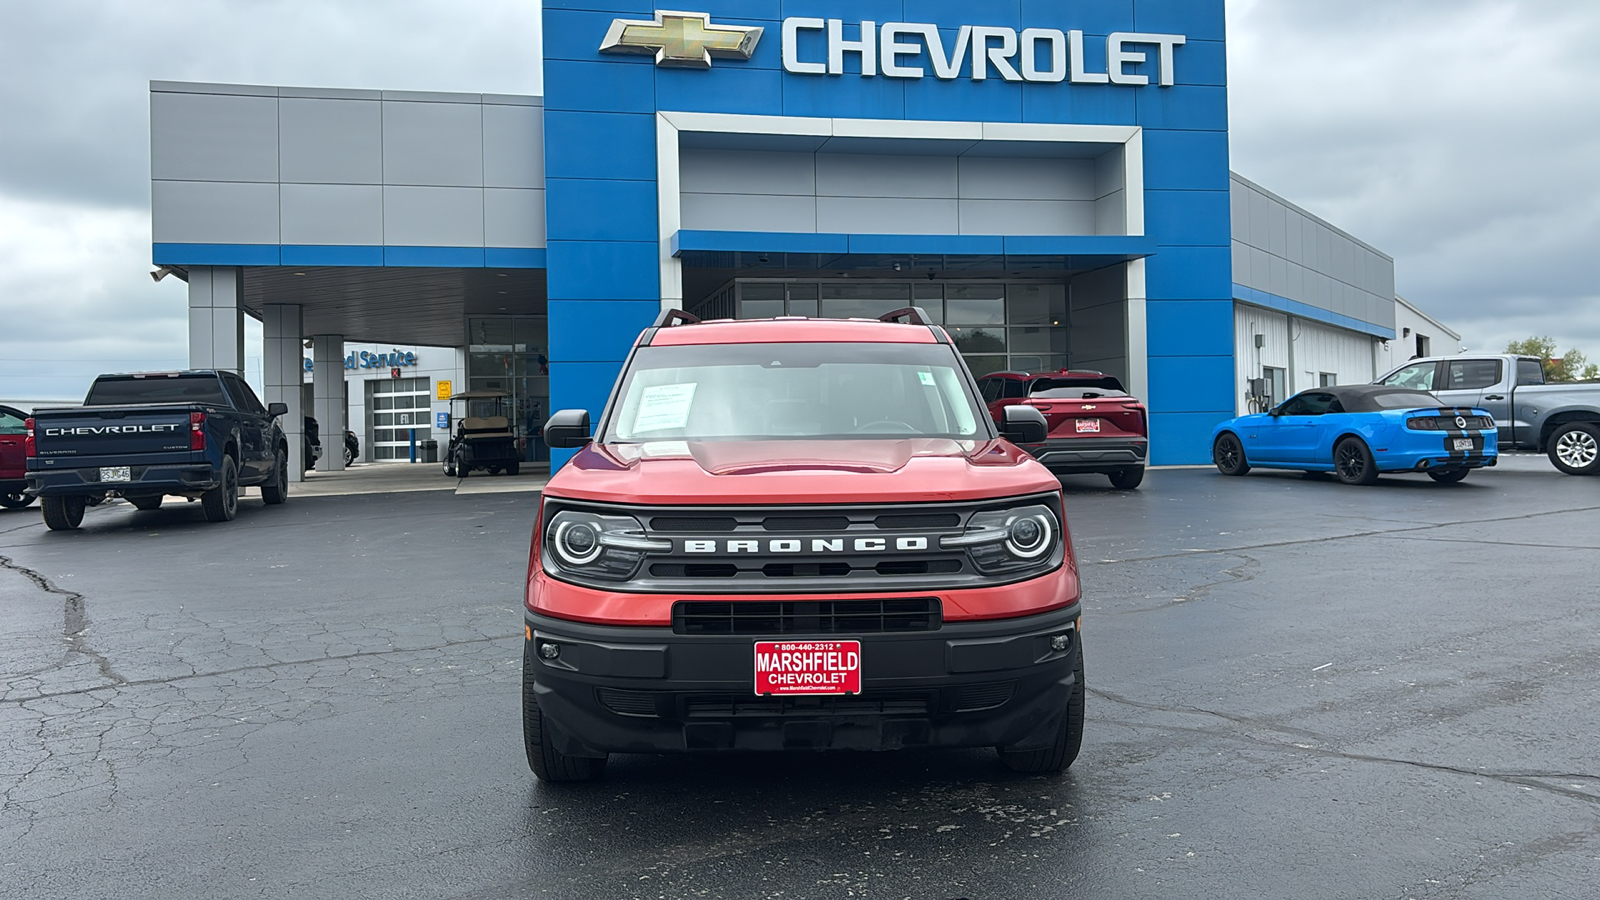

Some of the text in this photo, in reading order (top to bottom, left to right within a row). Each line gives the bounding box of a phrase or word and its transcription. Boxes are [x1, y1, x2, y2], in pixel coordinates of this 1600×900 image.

[782, 16, 1187, 86] CHEVROLET
[360, 348, 415, 368] Service
[45, 424, 180, 436] CHEVROLET
[684, 537, 928, 553] BRONCO
[781, 643, 834, 651] 800-440-2312
[757, 651, 859, 672] MARSHFIELD
[768, 672, 848, 685] CHEVROLET
